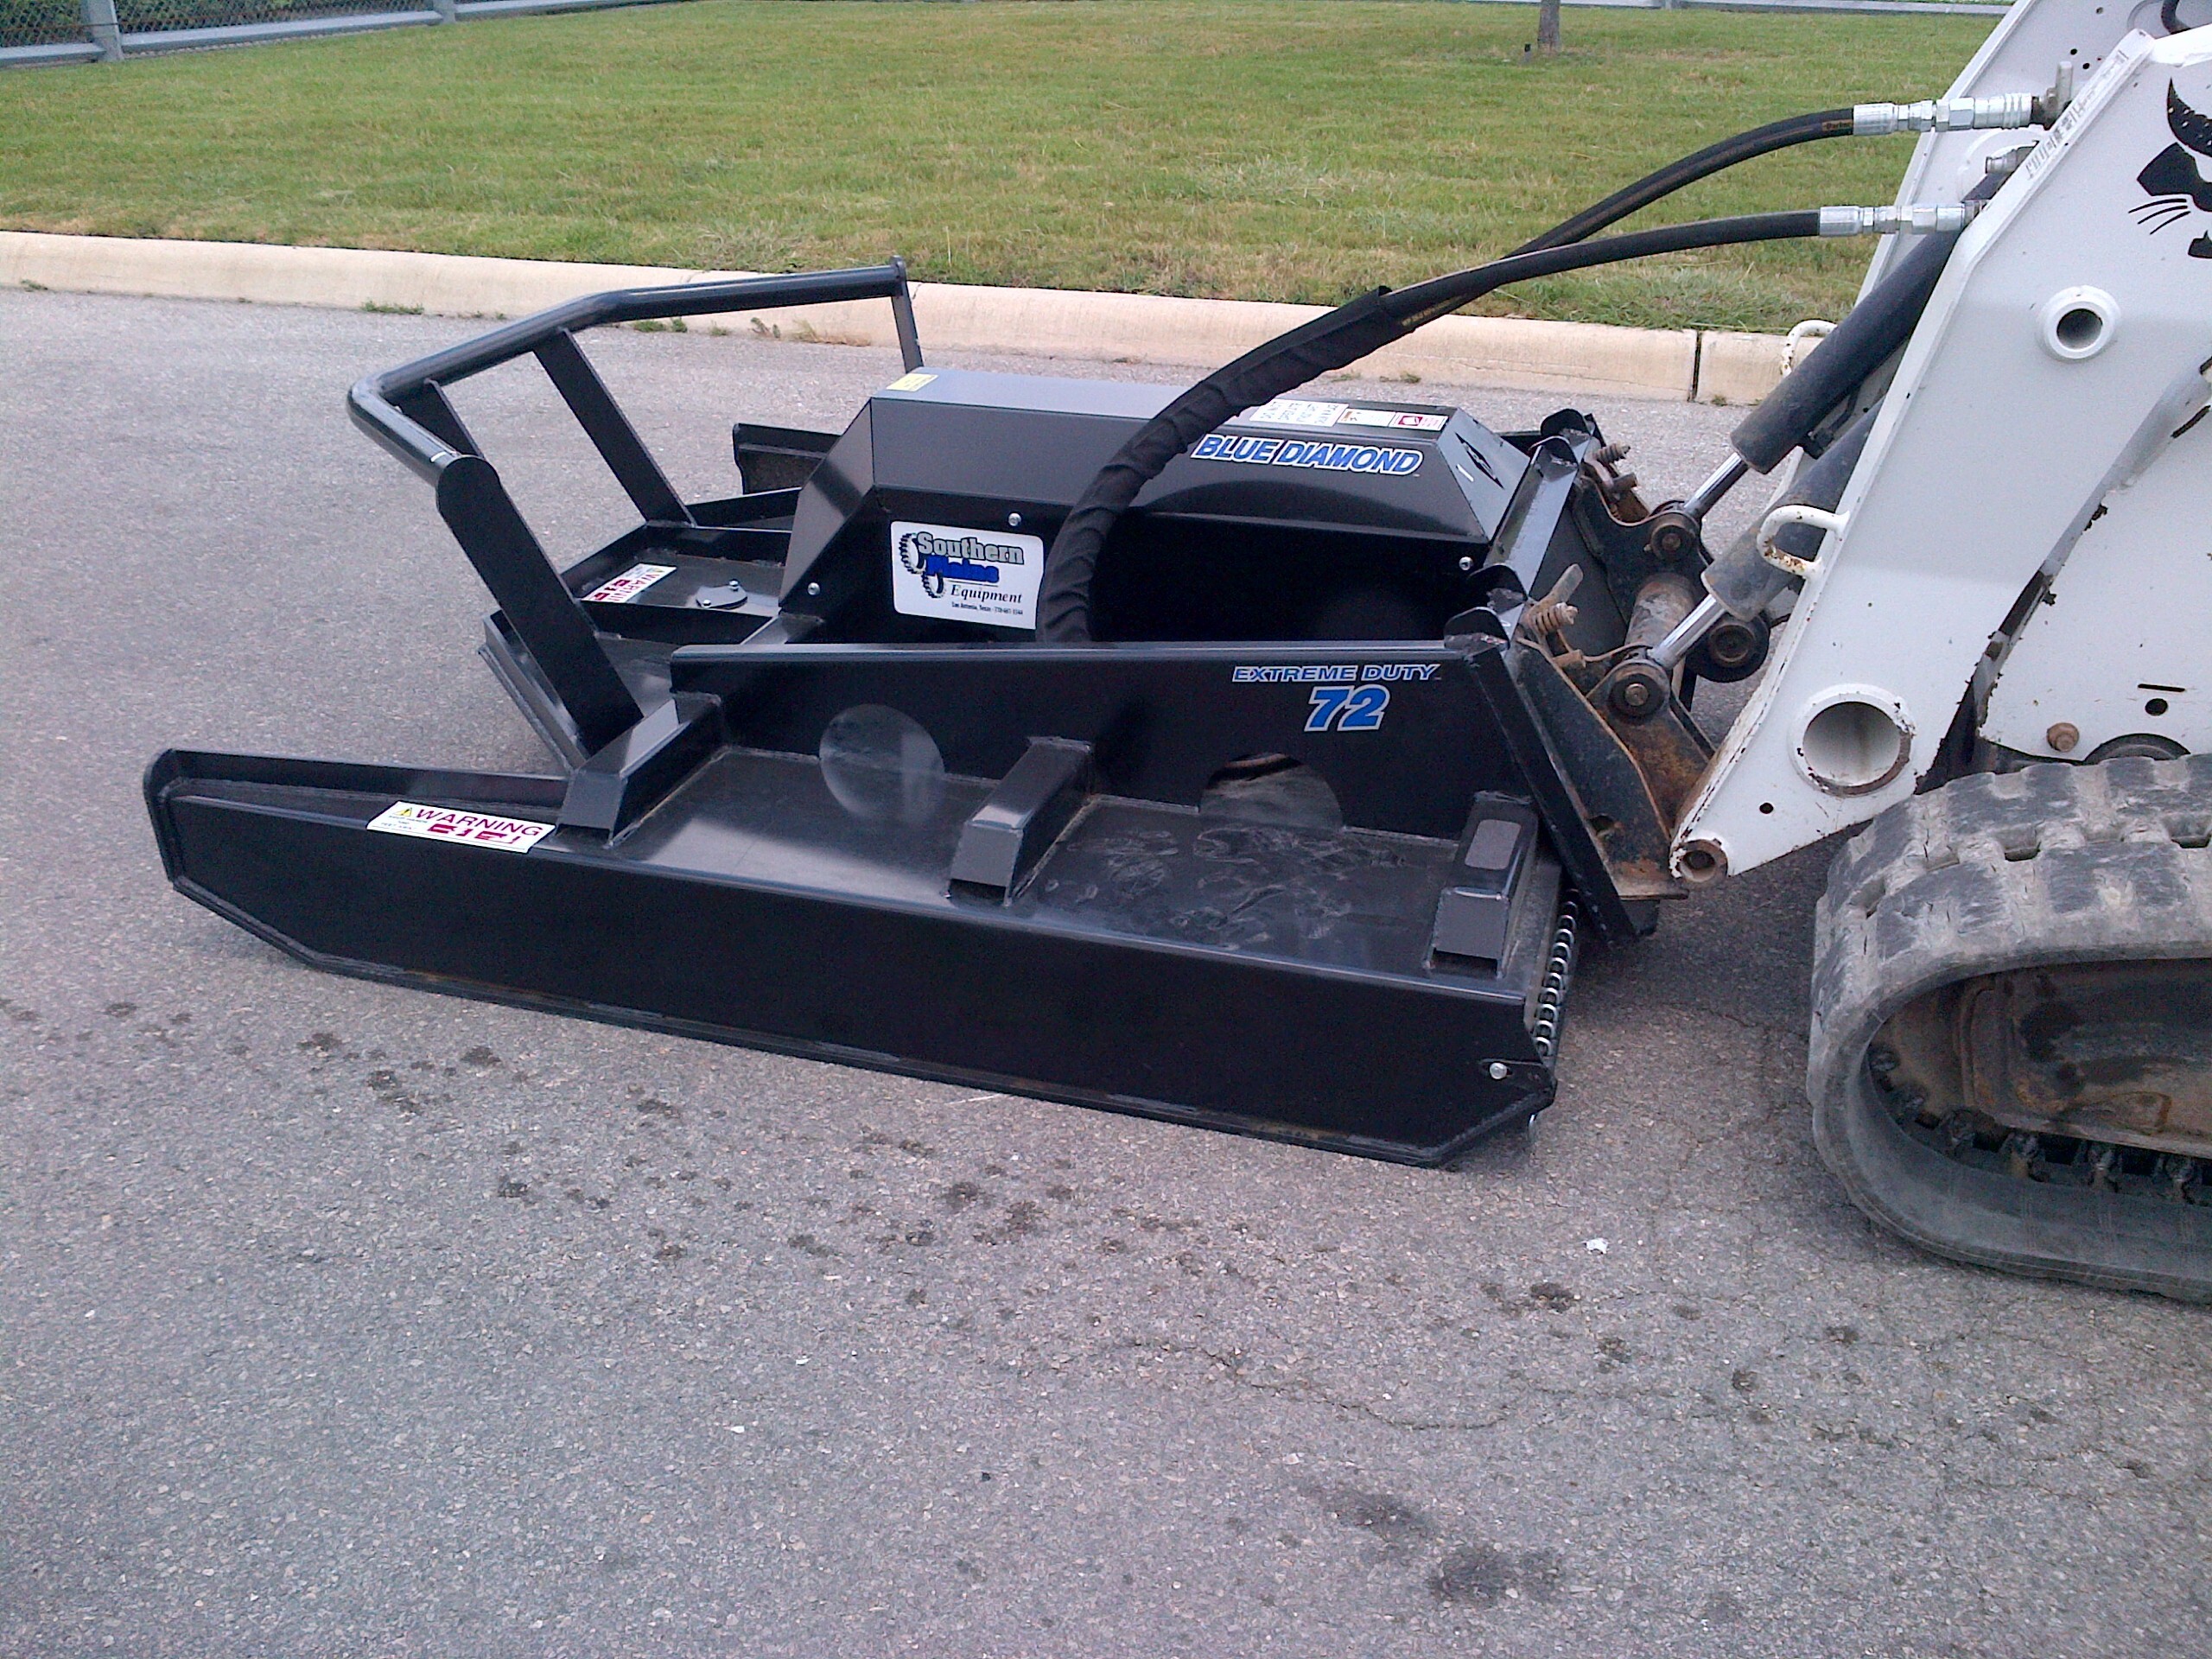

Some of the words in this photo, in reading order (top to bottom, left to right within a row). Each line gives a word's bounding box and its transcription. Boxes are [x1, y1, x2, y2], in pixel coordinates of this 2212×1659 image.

[1192, 434, 1283, 464] BLUE
[1273, 440, 1424, 475] DIAMOND
[916, 531, 1025, 564] Southern
[950, 584, 1022, 604] Equipment
[1232, 665, 1357, 682] EXTREME
[1361, 664, 1440, 681] DUTY
[1304, 684, 1390, 732] 72
[416, 809, 543, 836] WARNING
